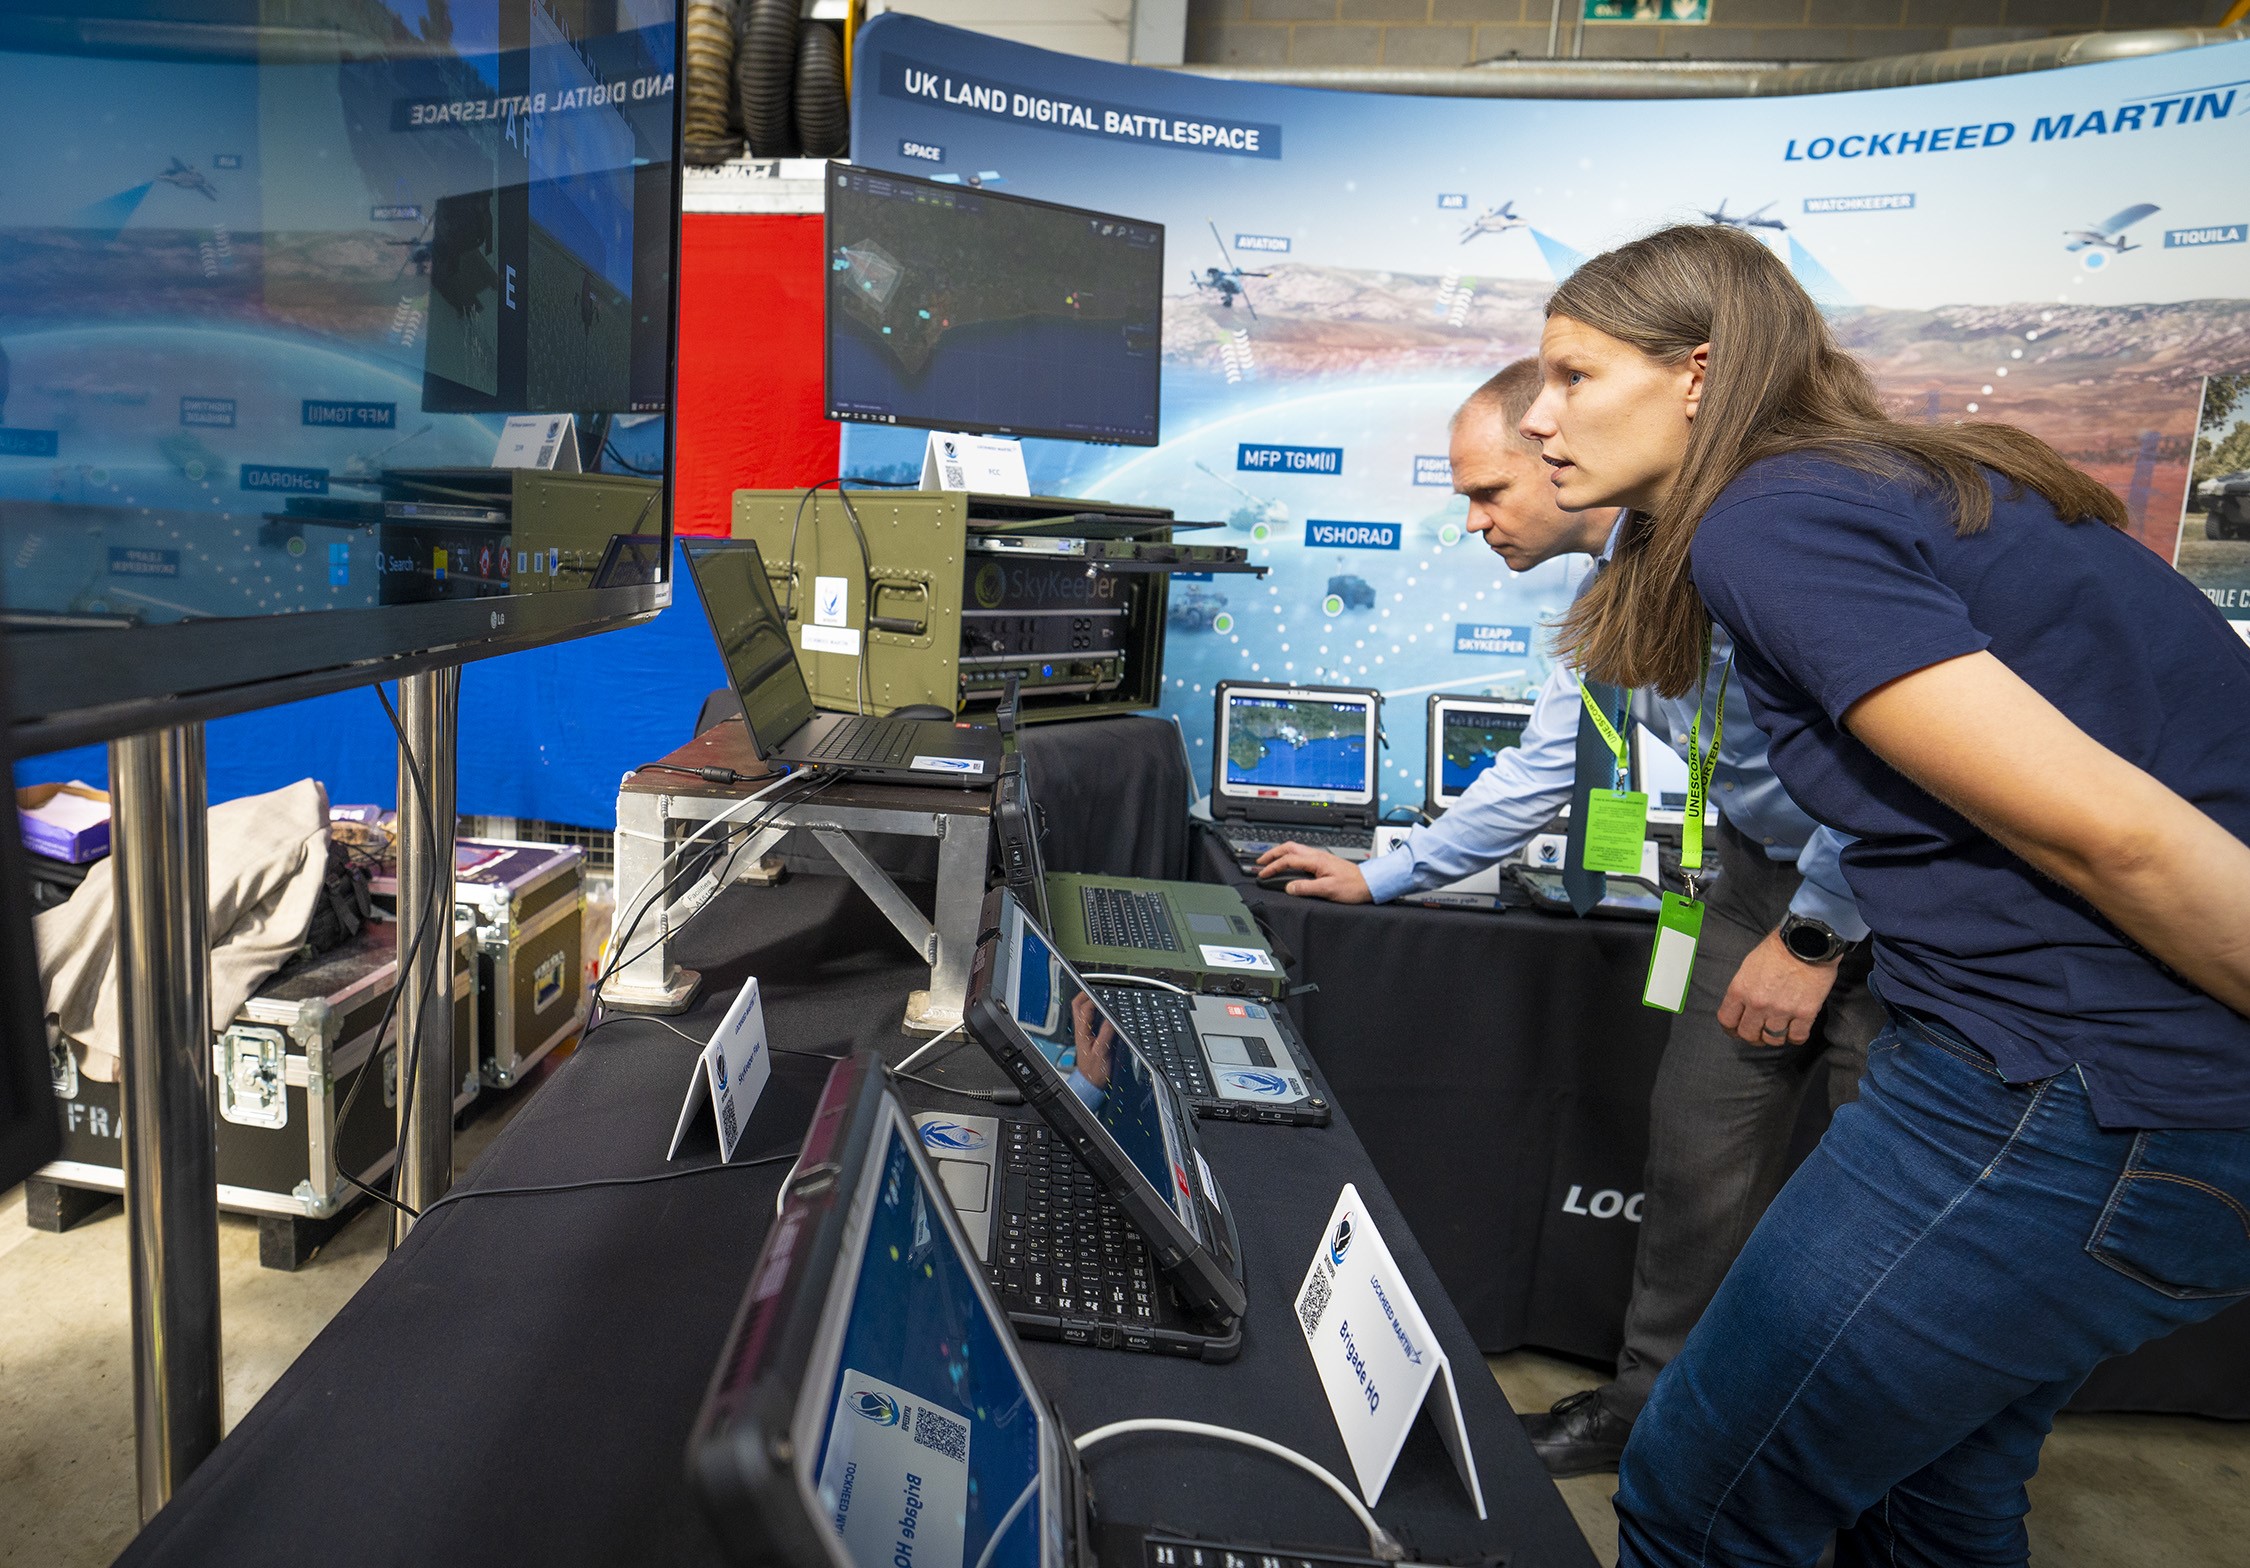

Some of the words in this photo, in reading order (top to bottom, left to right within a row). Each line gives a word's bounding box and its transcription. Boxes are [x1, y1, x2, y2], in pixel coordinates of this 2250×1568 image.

[905, 68, 938, 98] UK
[944, 78, 1007, 114] LAND
[1013, 94, 1099, 131] DIGITAL
[1104, 110, 1260, 152] BATTLESPACE
[1784, 121, 2016, 162] LOCKHEED
[2030, 89, 2238, 143] MARTIN
[903, 142, 941, 161] SPACE
[1442, 195, 1464, 208] AIR
[1806, 194, 1912, 212] WATCHKEEPER
[1238, 236, 1288, 251] AVIATION
[2172, 227, 2241, 246] TIQUILA
[1244, 449, 1281, 467] MFP
[1312, 526, 1394, 546] VSHORAD
[389, 555, 414, 572] Search
[1473, 627, 1512, 641] LEAPP
[1458, 639, 1526, 655] SKYKEEPER
[1688, 725, 1700, 818] UNESCORTED
[1370, 1274, 1395, 1322] LOCKHEED
[1392, 1318, 1412, 1357] MARTIN
[1339, 1319, 1367, 1386] Brigade
[1364, 1383, 1380, 1415] HQ
